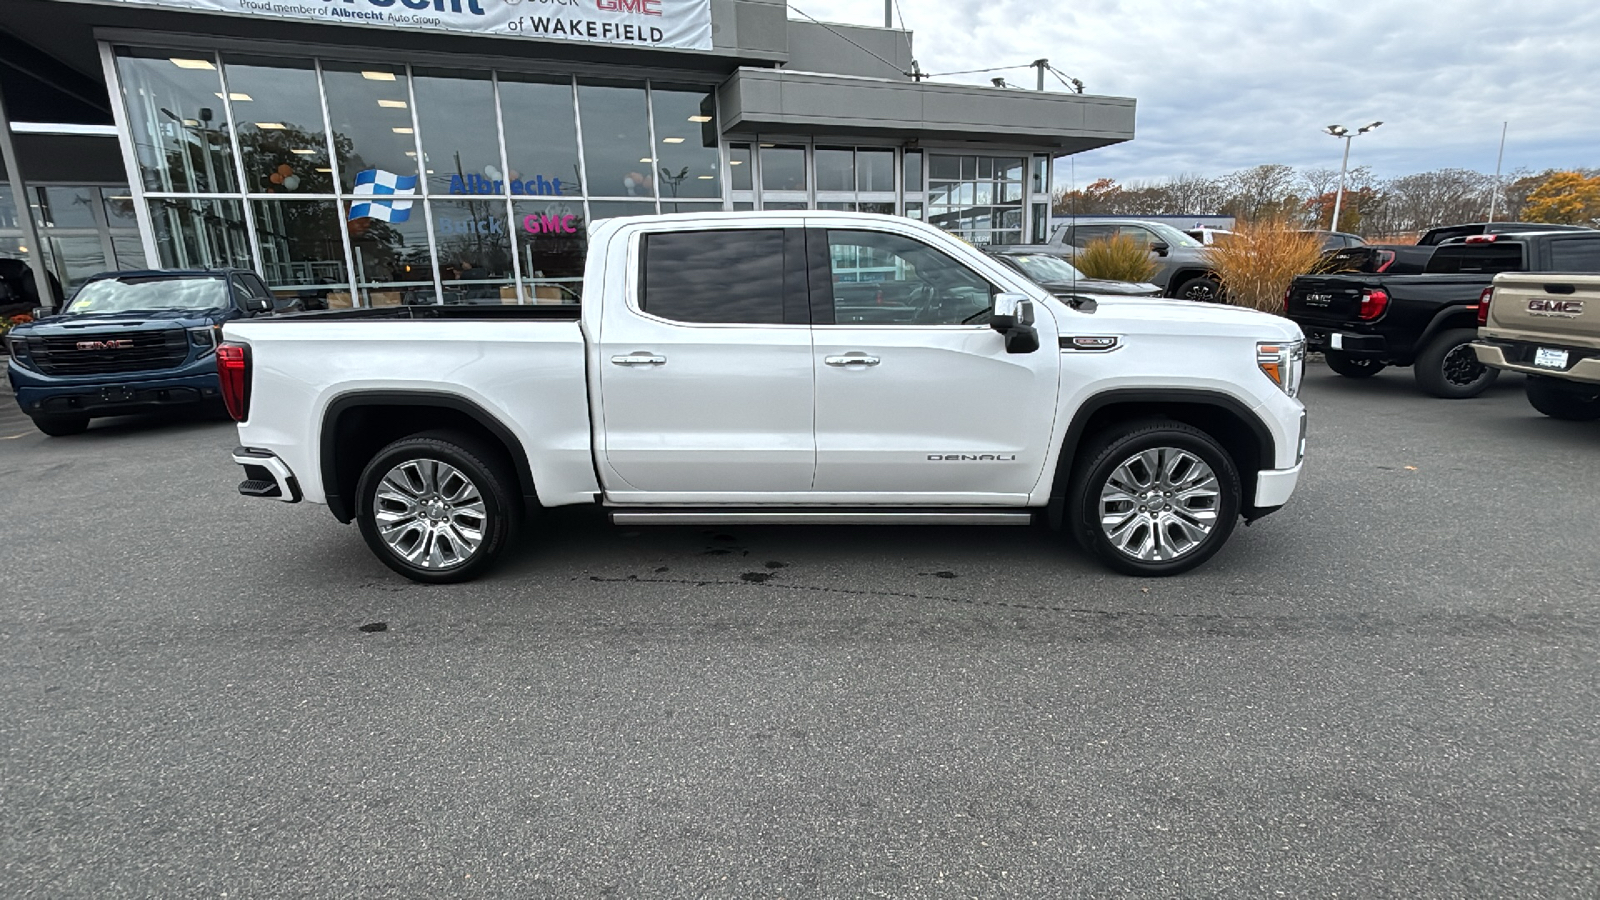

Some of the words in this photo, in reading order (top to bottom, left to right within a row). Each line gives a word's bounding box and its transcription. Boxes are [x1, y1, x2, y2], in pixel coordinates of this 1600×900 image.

[240, 0, 271, 10] Proud
[273, 4, 316, 14] member
[318, 6, 328, 15] of
[331, 8, 384, 20] Albrecht
[388, 13, 410, 23] Auto
[412, 14, 441, 26] Group
[597, 0, 662, 16] GMC
[507, 17, 524, 31] of
[530, 16, 664, 42] WAKEFIELD
[449, 173, 563, 195] Albrecht
[439, 215, 504, 234] Buick
[523, 214, 577, 233] GMC
[1528, 300, 1584, 314] GMC
[76, 339, 134, 351] GMC
